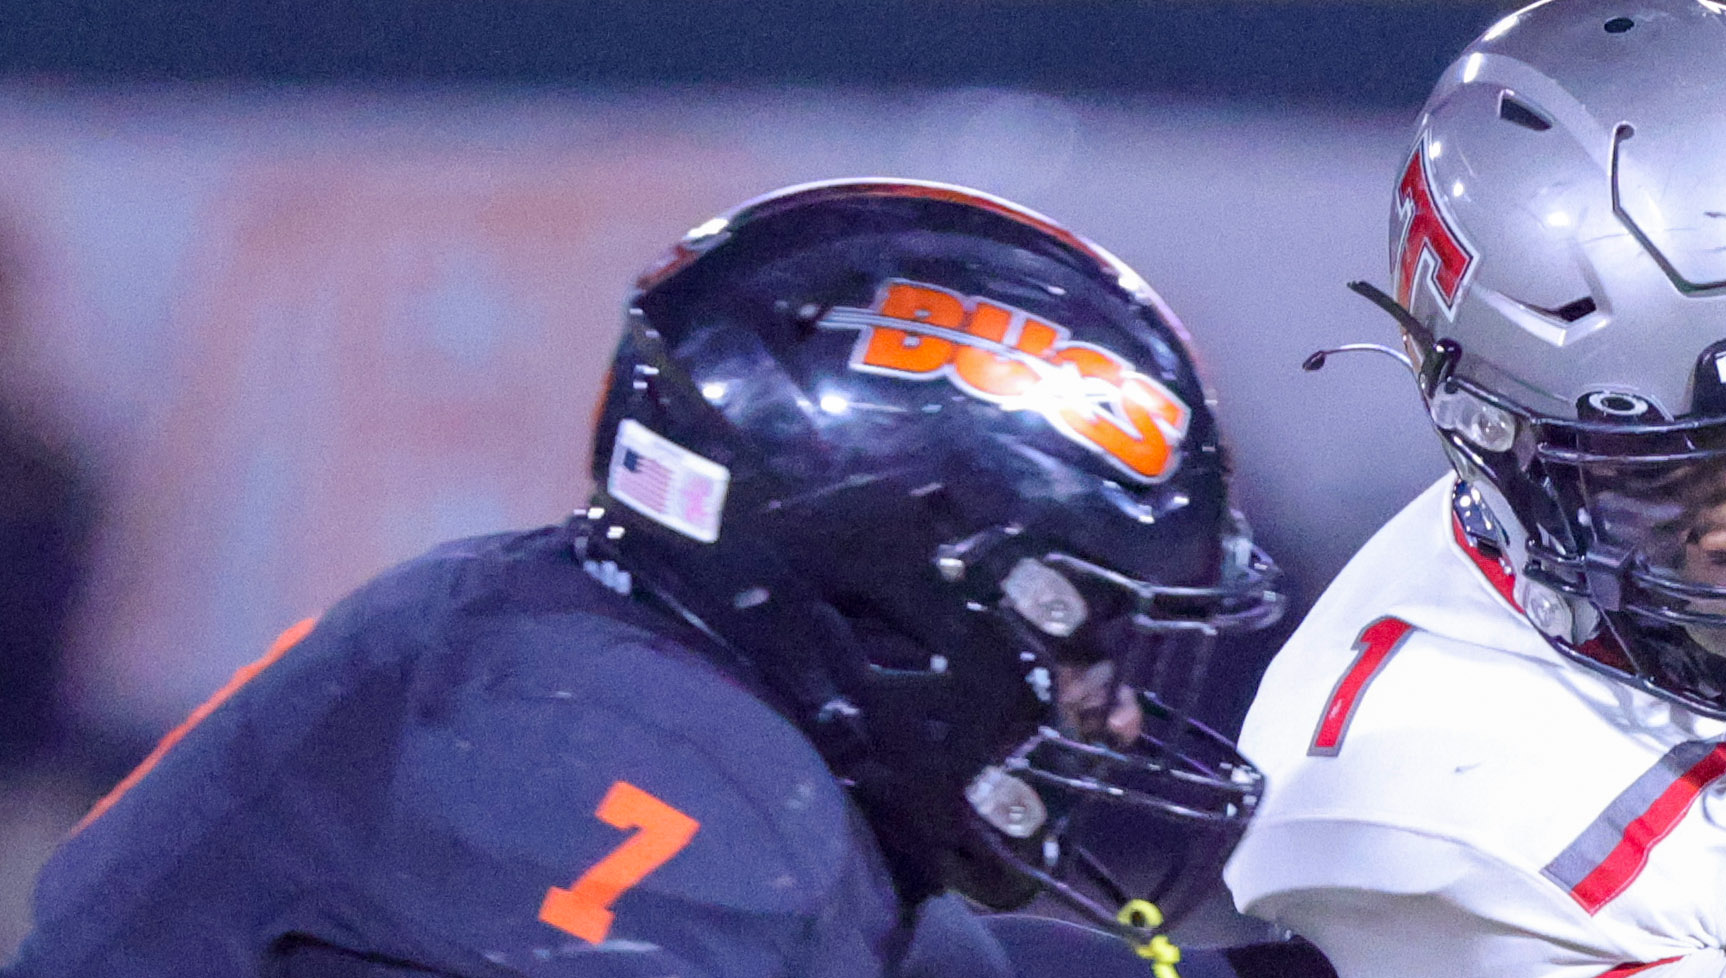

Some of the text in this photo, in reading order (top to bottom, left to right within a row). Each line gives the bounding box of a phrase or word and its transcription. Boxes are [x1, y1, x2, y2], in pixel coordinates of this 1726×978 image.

[849, 278, 1193, 484] BUCS
[1306, 614, 1418, 758] 1
[538, 780, 701, 946] 7
